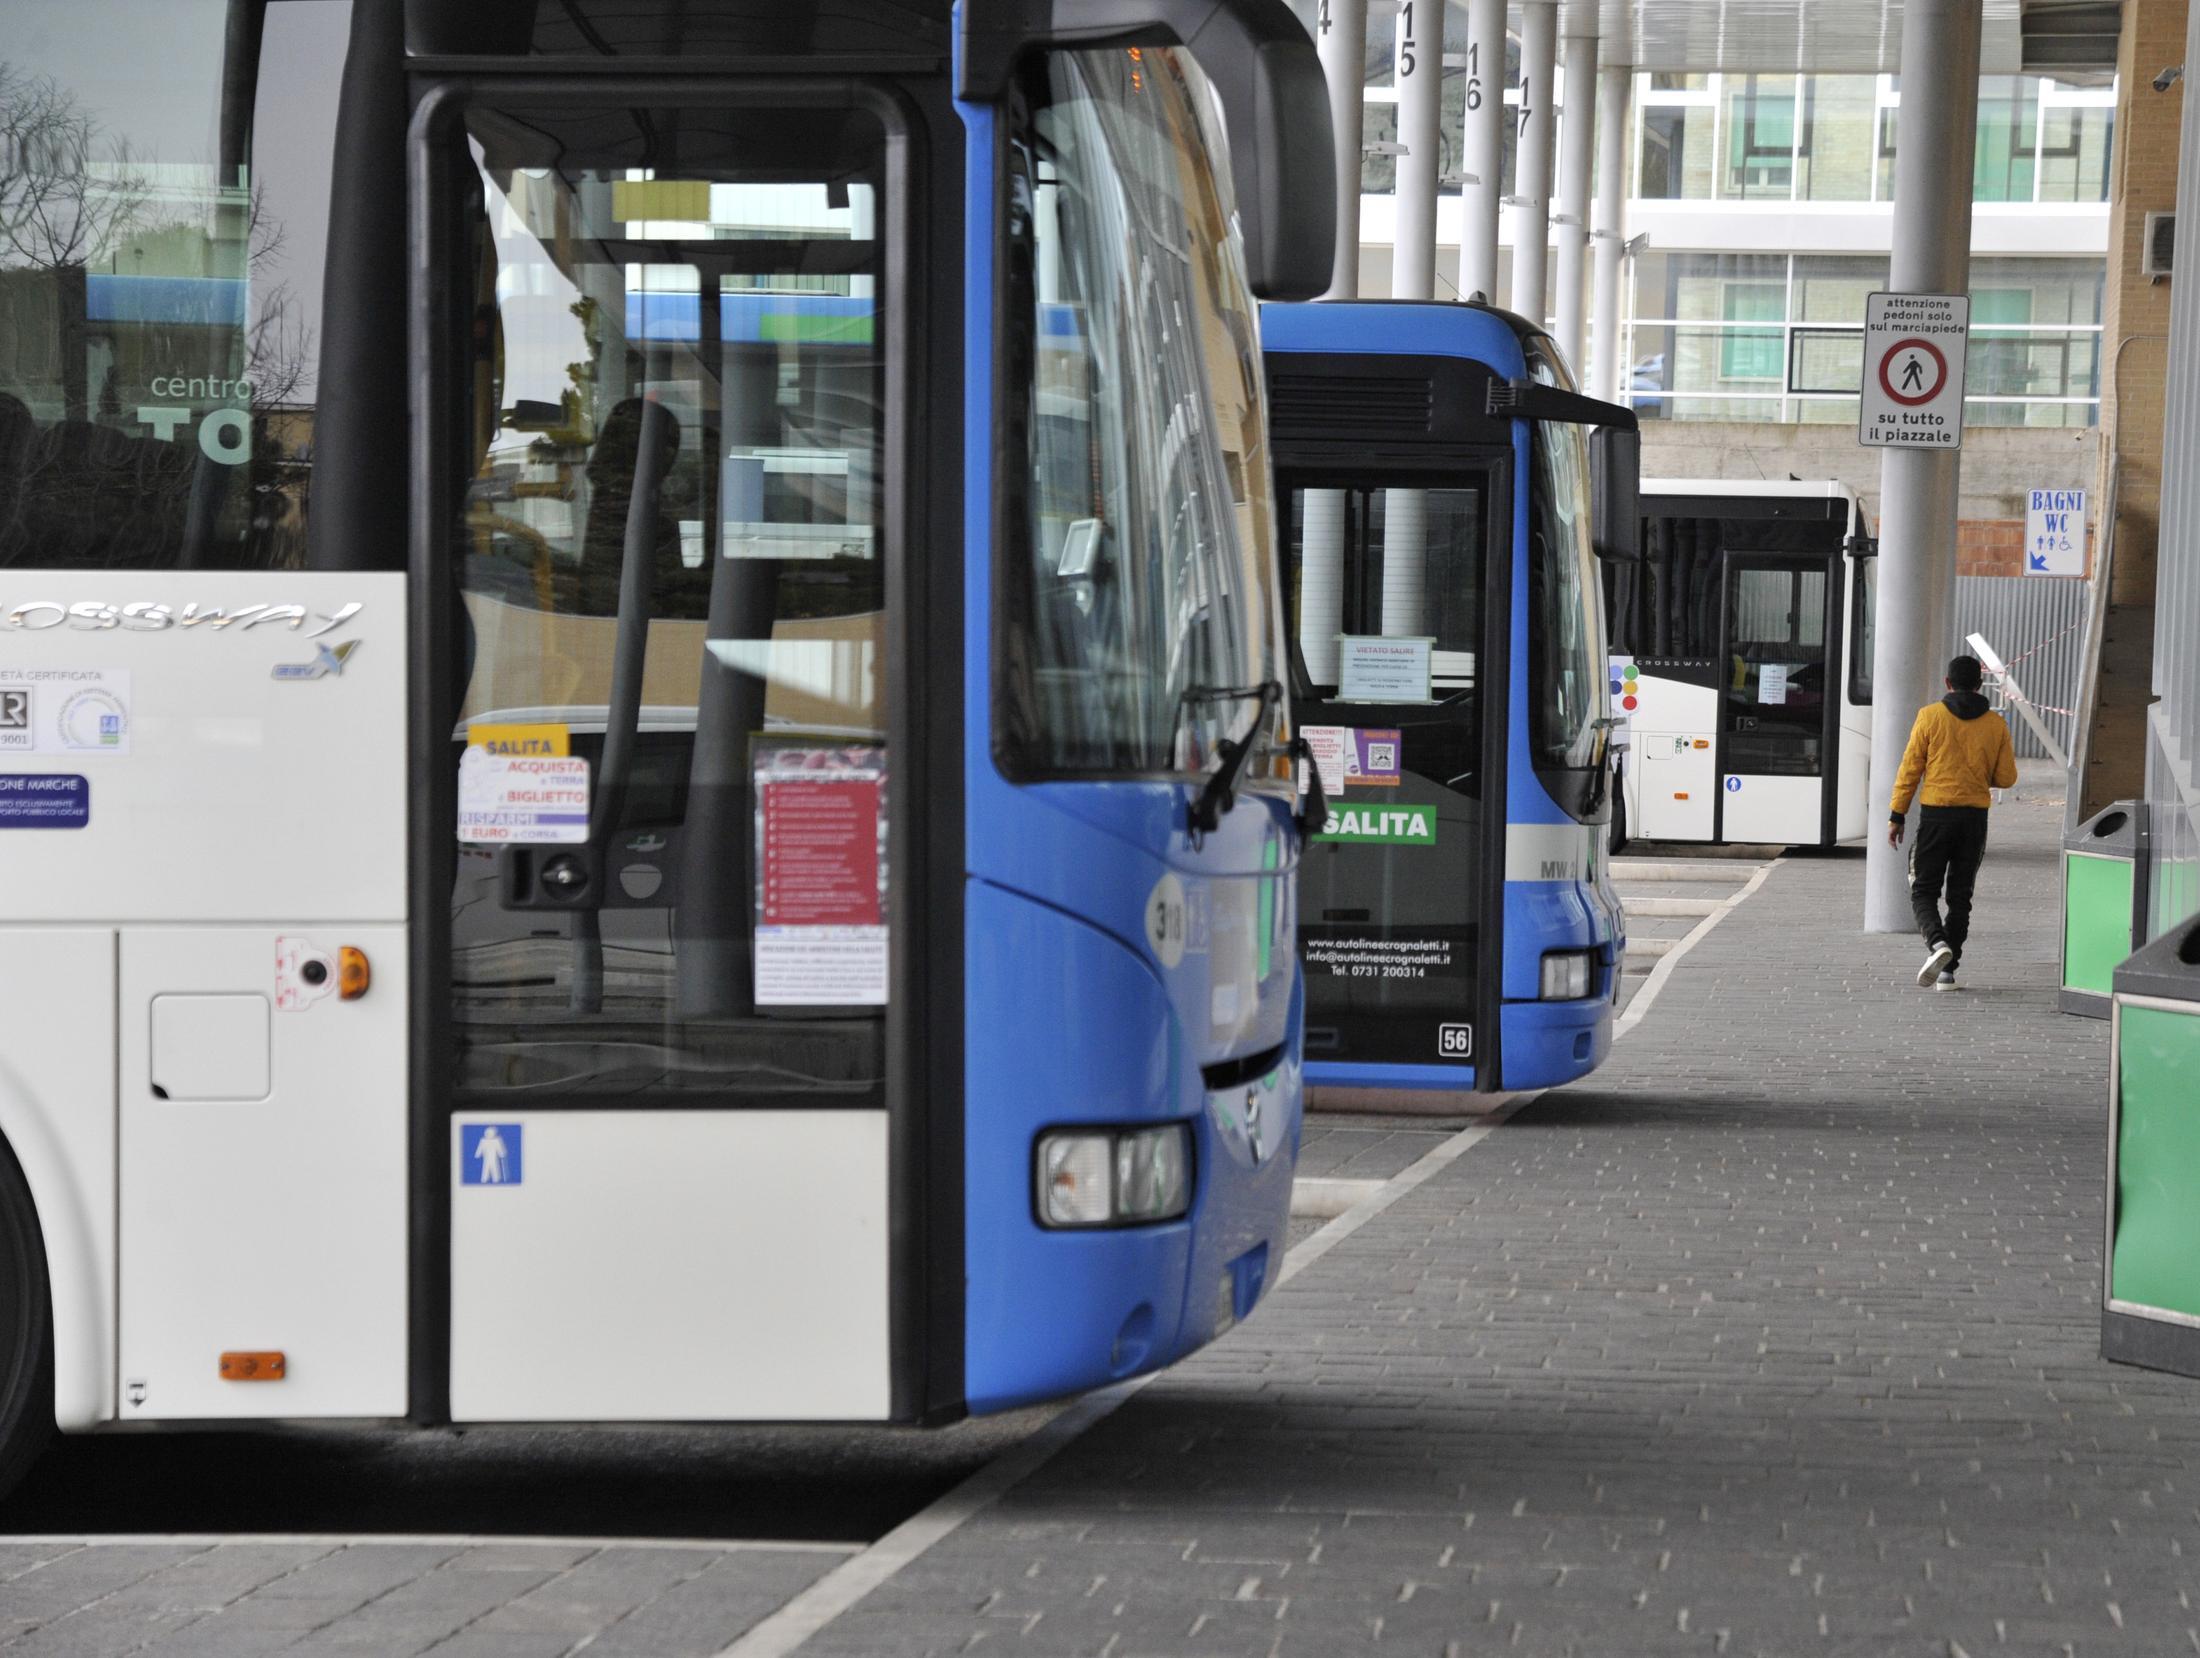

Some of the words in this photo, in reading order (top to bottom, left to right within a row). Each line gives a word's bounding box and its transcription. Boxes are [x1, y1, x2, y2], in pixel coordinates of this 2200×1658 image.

[1887, 299, 1951, 309] attenzione
[1883, 310, 1924, 321] pedoni
[1928, 312, 1953, 321] solo
[1869, 323, 1887, 332] sul
[1891, 323, 1965, 335] marciapiede
[150, 375, 253, 399] centro
[1878, 414, 1896, 424] su
[1902, 412, 1945, 425] tutto
[1869, 428, 1879, 440] il
[1885, 429, 1952, 443] piazzale
[2031, 491, 2083, 511] BAGNI
[2045, 513, 2068, 533] WC
[26, 671, 103, 681] CERTIFICATA
[0, 735, 27, 745] 9001
[487, 740, 552, 755] SALITA
[507, 761, 585, 774] ACQUISTA
[27, 780, 77, 791] MARCHE
[506, 791, 585, 804] BIGLIETTO
[1322, 810, 1429, 837] SALITA
[471, 828, 510, 839] EURO
[1307, 938, 1450, 952] www.autolineecrognaletti.it
[1306, 951, 1451, 965] info@autolineecrognaletti.it
[1331, 966, 1349, 976] Tel.
[1352, 966, 1378, 977] 0731
[1383, 967, 1425, 978] 200314
[1444, 1030, 1467, 1050] 56
